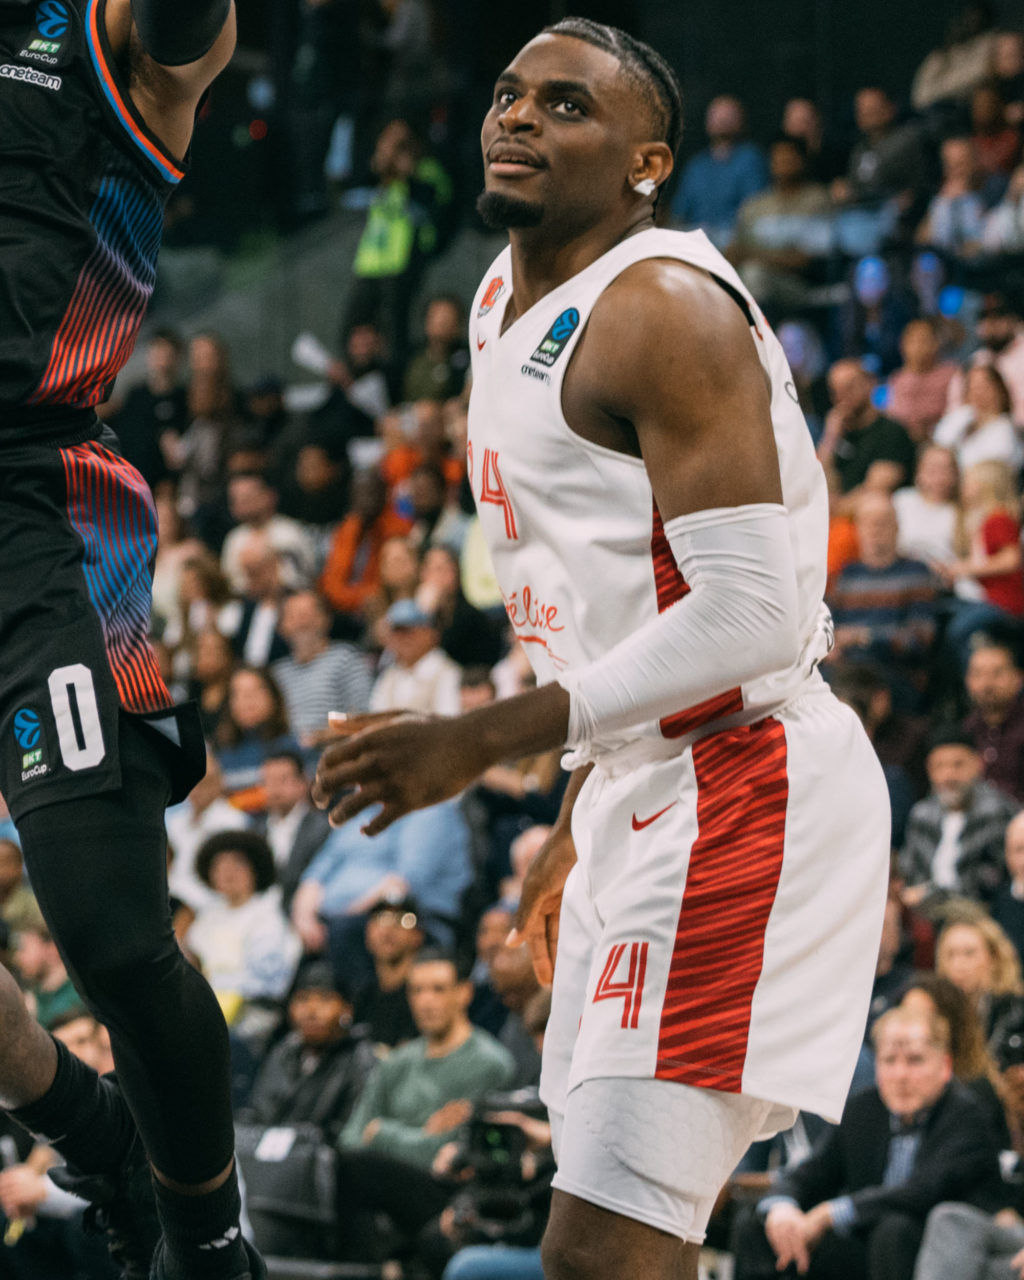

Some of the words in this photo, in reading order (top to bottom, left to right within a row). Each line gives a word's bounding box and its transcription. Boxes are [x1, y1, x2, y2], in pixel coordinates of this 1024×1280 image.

[19, 49, 58, 65] EuroCup
[467, 440, 518, 540] 4
[47, 663, 106, 772] 0
[21, 764, 47, 782] EuroCup
